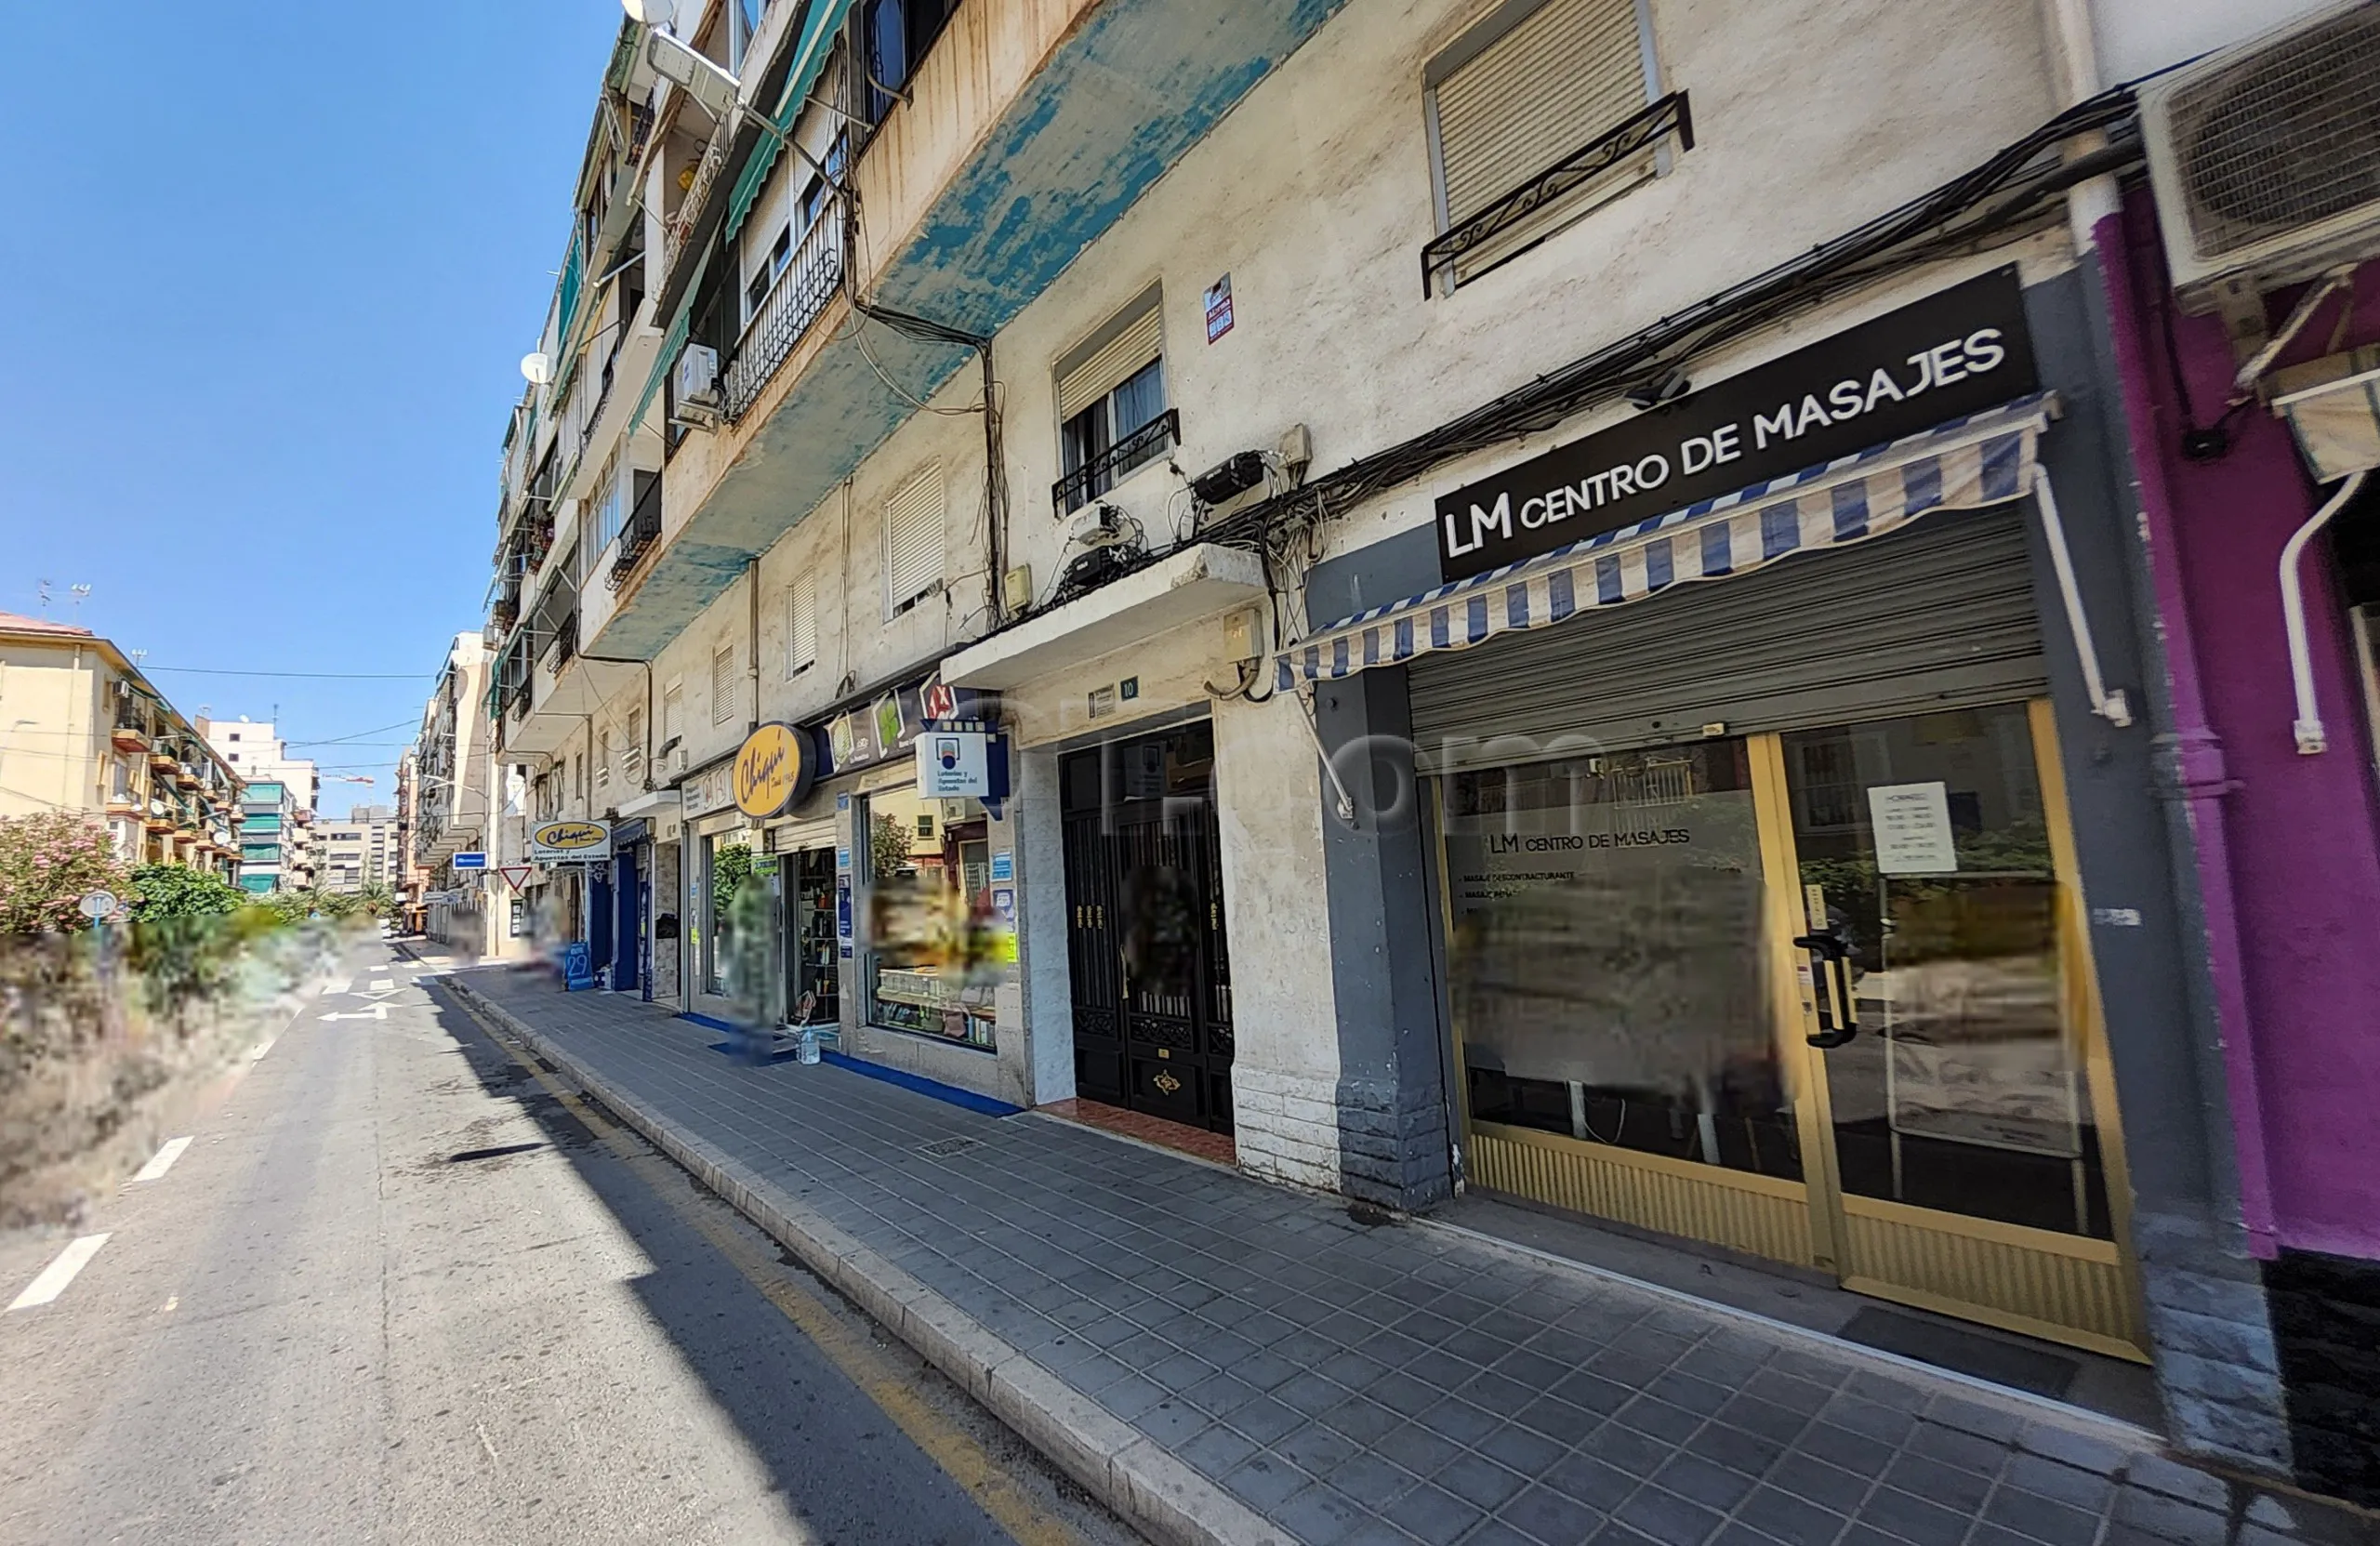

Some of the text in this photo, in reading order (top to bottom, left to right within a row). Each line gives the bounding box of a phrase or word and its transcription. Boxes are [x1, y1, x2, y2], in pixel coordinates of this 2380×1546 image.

[1445, 328, 2004, 558] LM CENTRO DE MASAJES
[1124, 681, 1134, 697] 10
[1489, 829, 1690, 853] LM CENTRO DE MASAJES
[567, 954, 588, 977] 29
